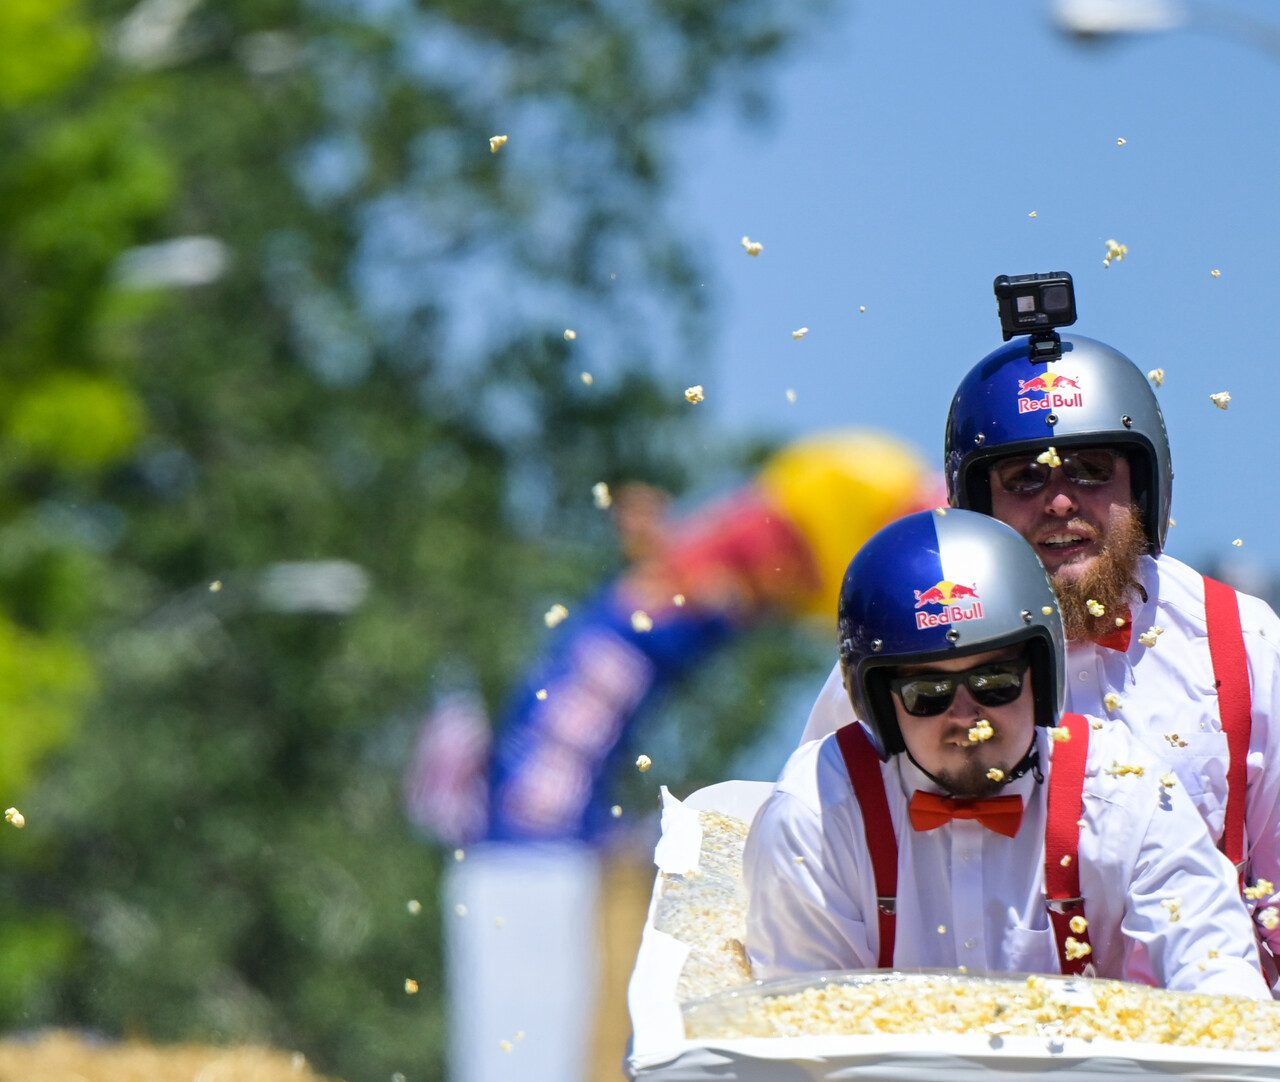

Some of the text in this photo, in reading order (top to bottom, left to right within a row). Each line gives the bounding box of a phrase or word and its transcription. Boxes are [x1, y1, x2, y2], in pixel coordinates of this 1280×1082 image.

[1018, 392, 1083, 413] Red Bull
[916, 602, 984, 629] Red Bull
